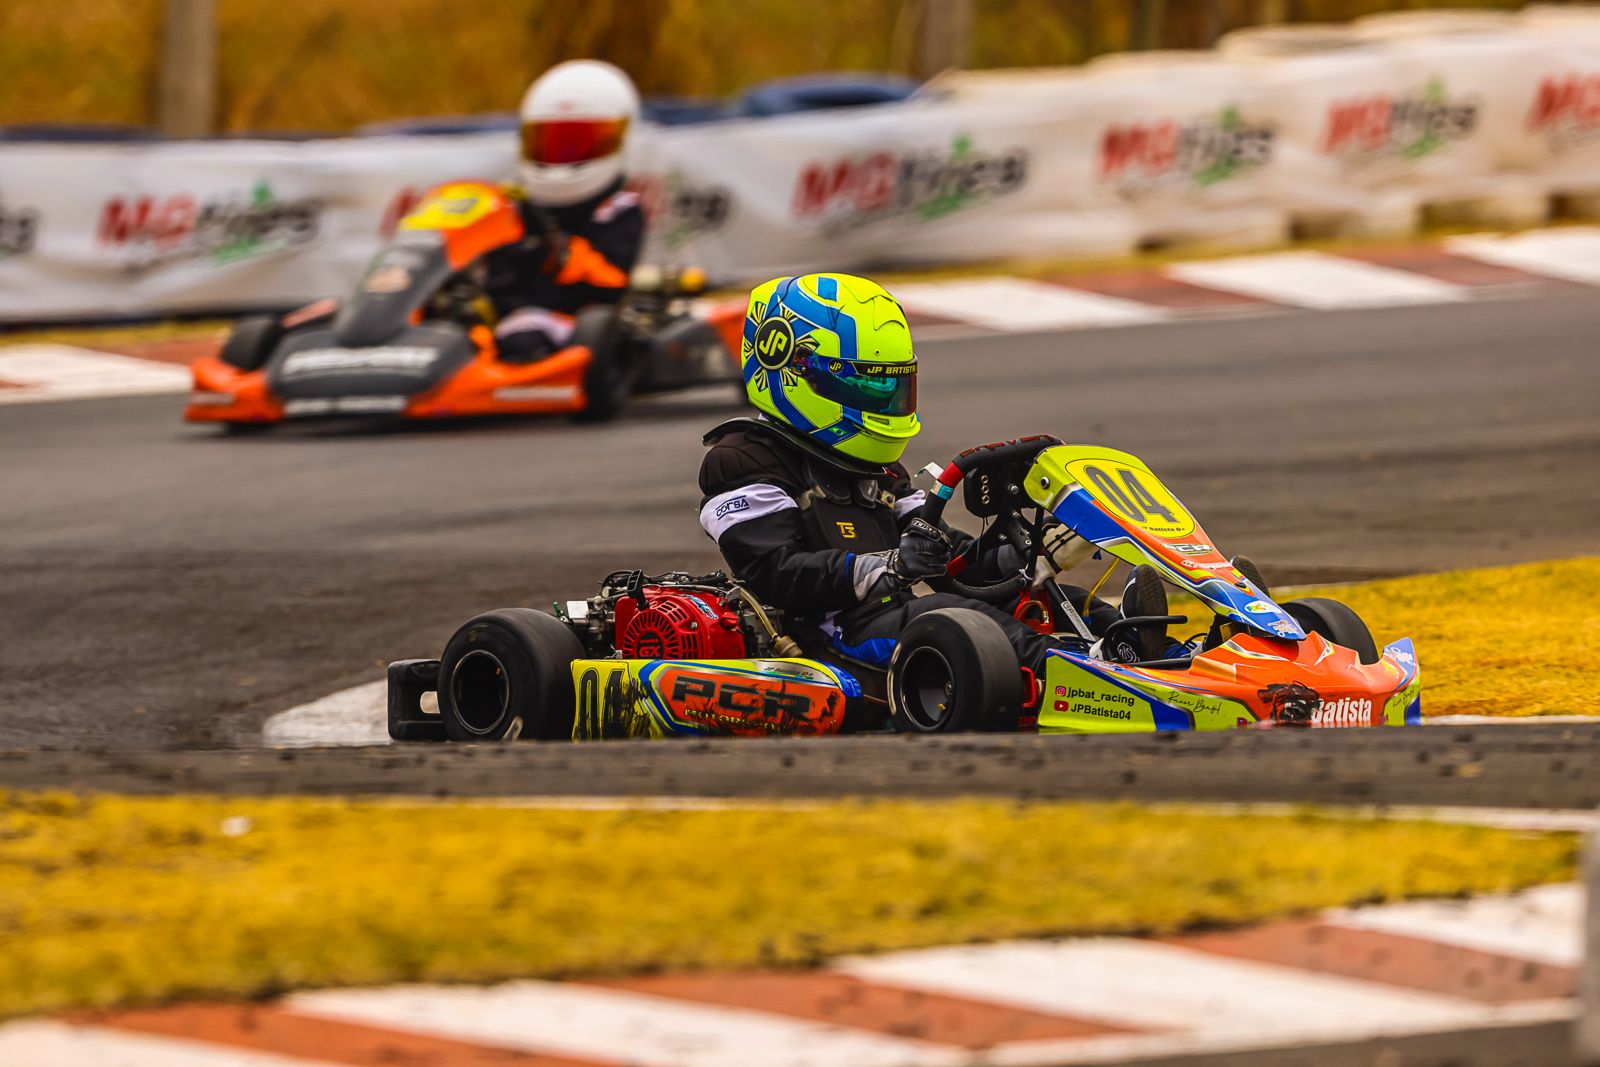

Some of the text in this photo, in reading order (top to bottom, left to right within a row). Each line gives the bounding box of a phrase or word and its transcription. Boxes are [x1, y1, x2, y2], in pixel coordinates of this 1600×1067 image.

[759, 329, 788, 356] JP
[829, 362, 842, 371] JP
[867, 366, 882, 374] JP
[1084, 465, 1181, 523] 04
[639, 646, 660, 657] GX
[672, 675, 811, 721] PCR
[1067, 687, 1135, 706] jpbat_racing
[1071, 703, 1131, 720] JPBatista04
[1311, 698, 1372, 726] Batista
